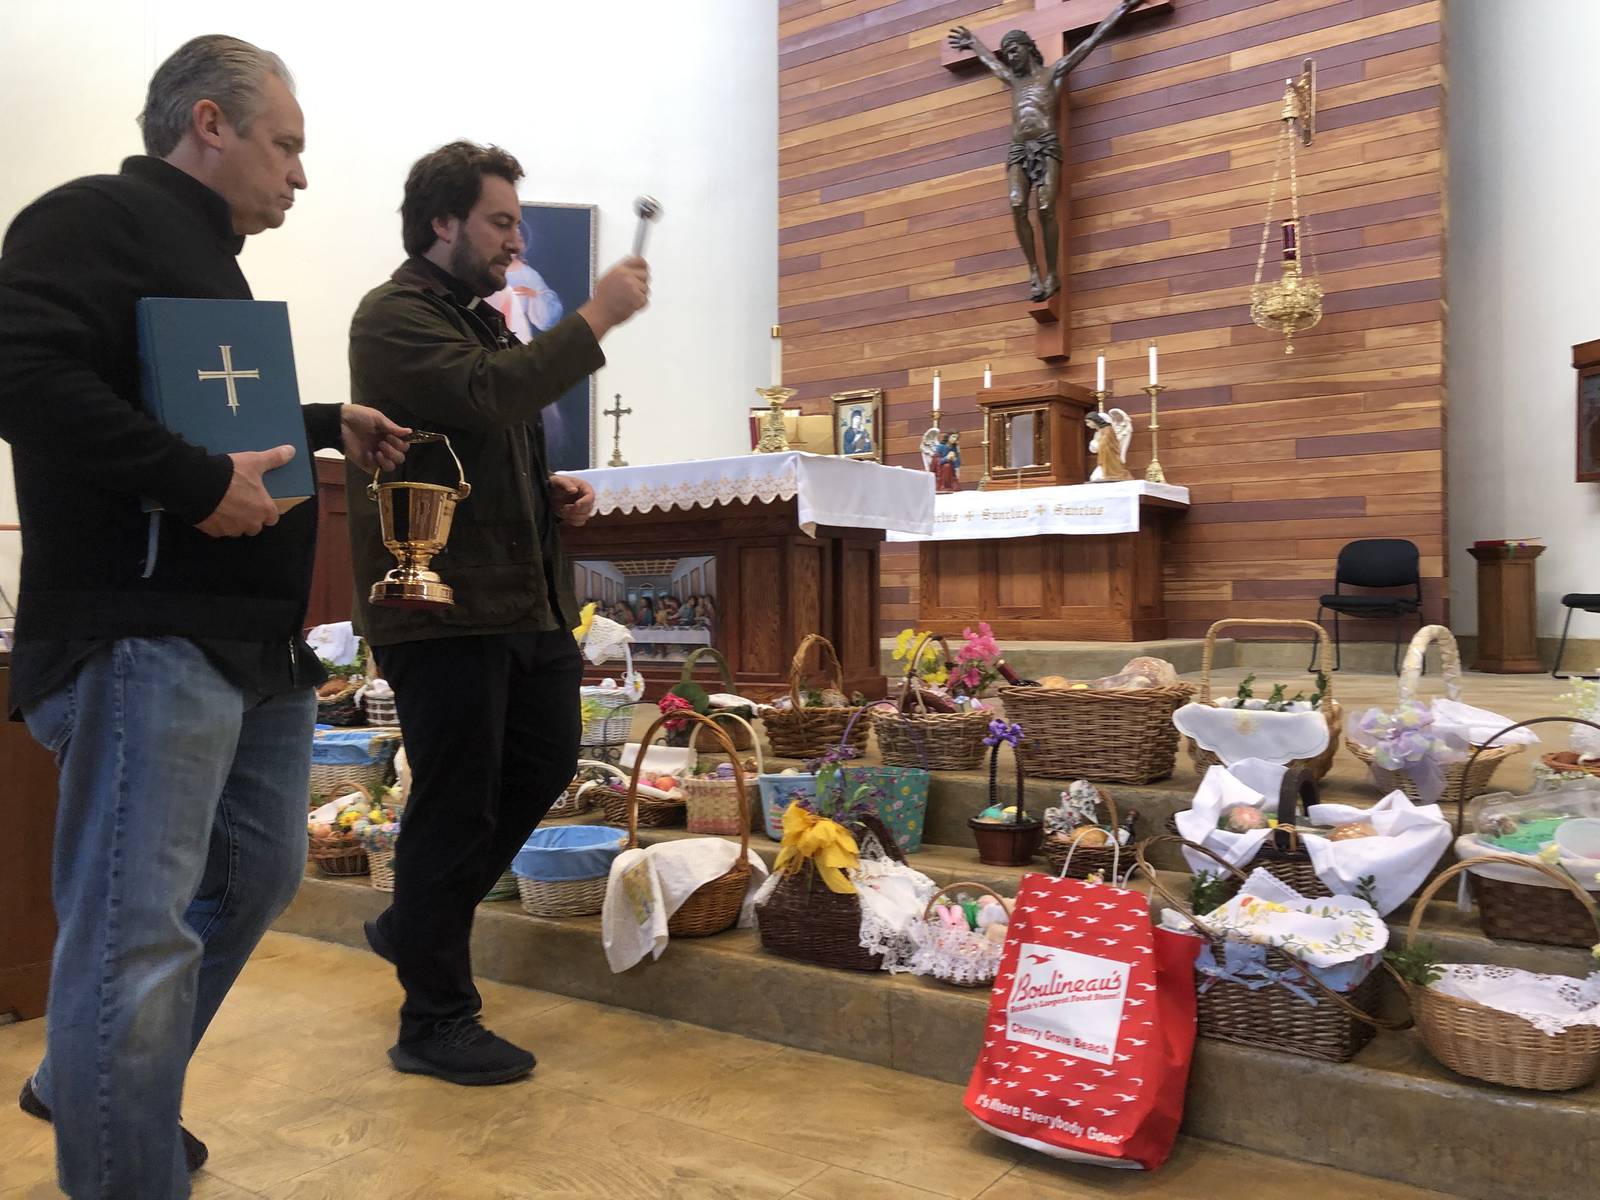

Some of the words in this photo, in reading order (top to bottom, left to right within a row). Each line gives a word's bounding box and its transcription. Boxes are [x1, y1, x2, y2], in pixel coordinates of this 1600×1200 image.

[1012, 970, 1122, 1002] Boulineau's
[1011, 1022, 1041, 1040] Cherry
[1044, 1030, 1072, 1046] Grove
[1074, 1037, 1110, 1055] Beach
[1022, 1106, 1084, 1138] Everybody
